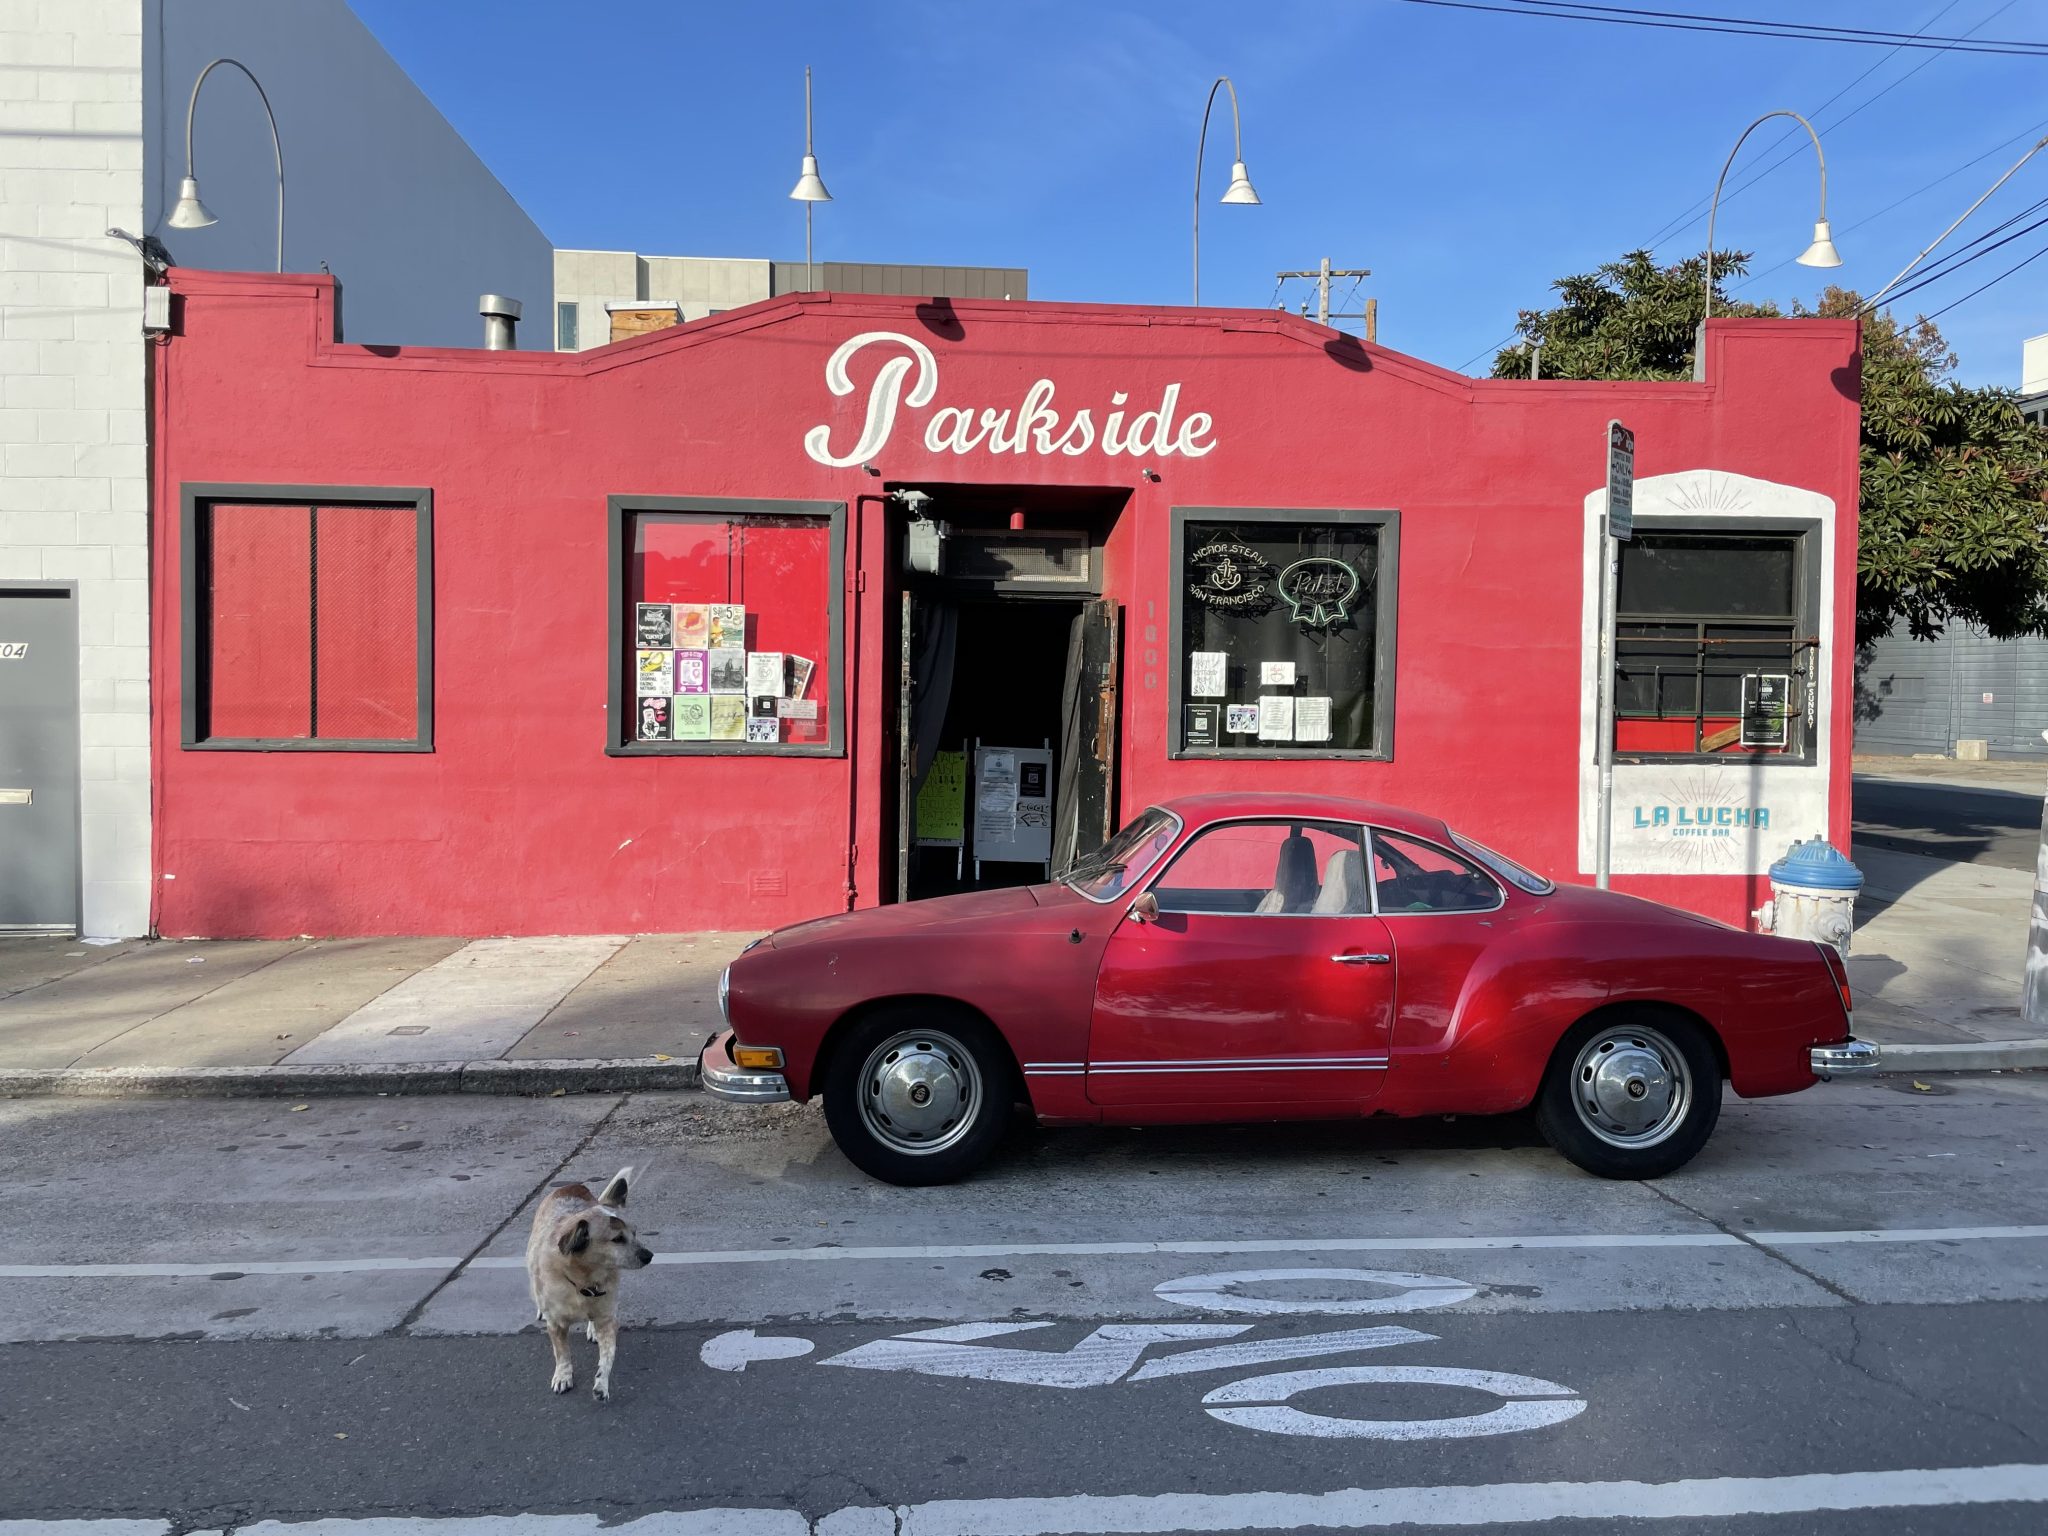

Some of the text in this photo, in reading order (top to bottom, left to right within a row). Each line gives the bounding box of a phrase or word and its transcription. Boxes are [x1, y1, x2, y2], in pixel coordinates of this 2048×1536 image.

[804, 331, 1218, 468] Parkside
[1231, 545, 1268, 567] STEAM
[1190, 584, 1265, 605] SAN FRANCISCO
[0, 644, 26, 657] 04
[1633, 806, 1771, 830] LA LUCHA
[1673, 828, 1730, 837] COFFEE BAR
